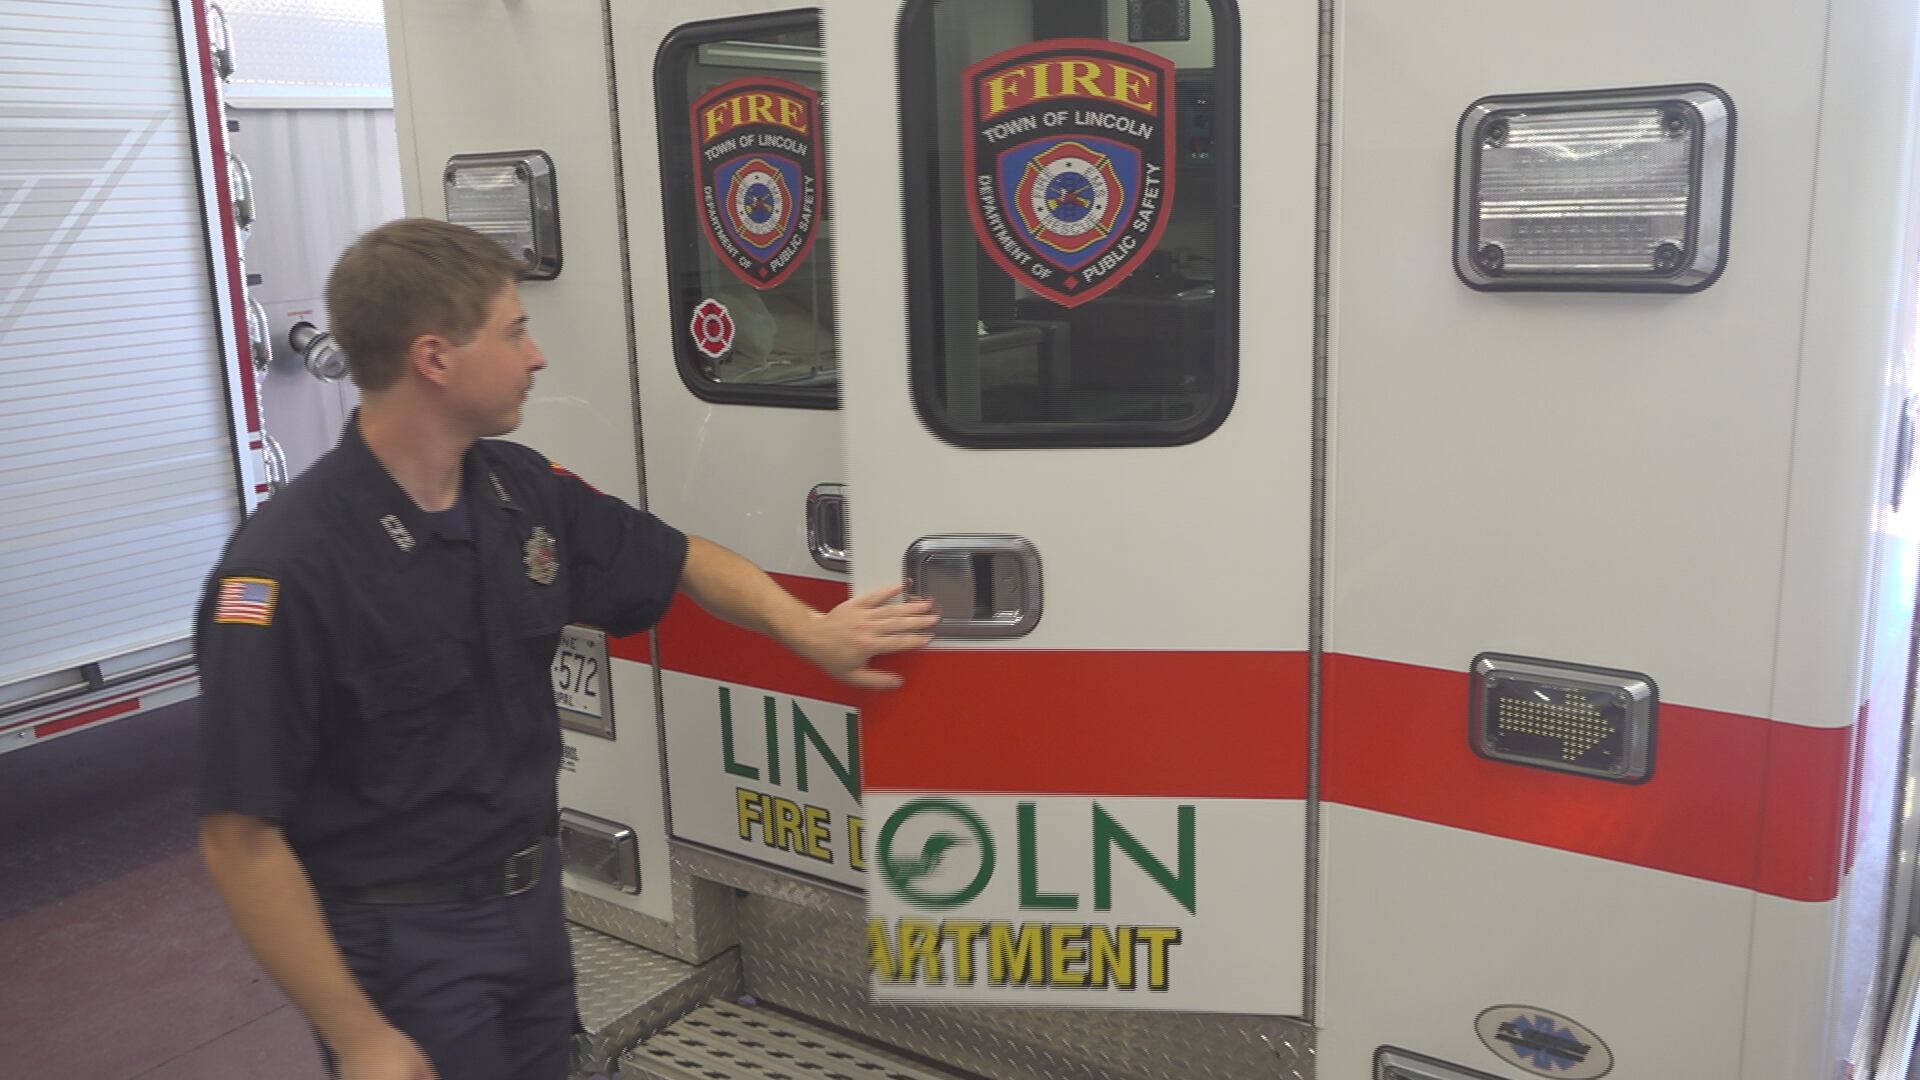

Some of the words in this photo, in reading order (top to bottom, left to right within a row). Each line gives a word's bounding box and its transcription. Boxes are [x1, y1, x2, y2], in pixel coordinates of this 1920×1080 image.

[703, 93, 807, 140] FIRE
[981, 115, 1038, 143] TOWN
[1043, 110, 1069, 128] OF
[1074, 110, 1154, 141] LINCOLN
[985, 61, 1154, 116] FIRE
[704, 137, 738, 161] TOWN
[739, 134, 756, 149] OF
[758, 134, 808, 157] LINCOLN
[704, 185, 739, 260] DEPARTMENT
[738, 252, 753, 271] OF
[769, 234, 804, 274] PUBLIC
[798, 175, 816, 233] SAFETY
[978, 174, 1033, 267] DEPARTMENT
[1032, 262, 1053, 280] OF
[1082, 235, 1138, 283] PUBLIC
[1133, 162, 1162, 234] SAFETY
[718, 685, 865, 809] LIN
[735, 786, 834, 865] FIRE
